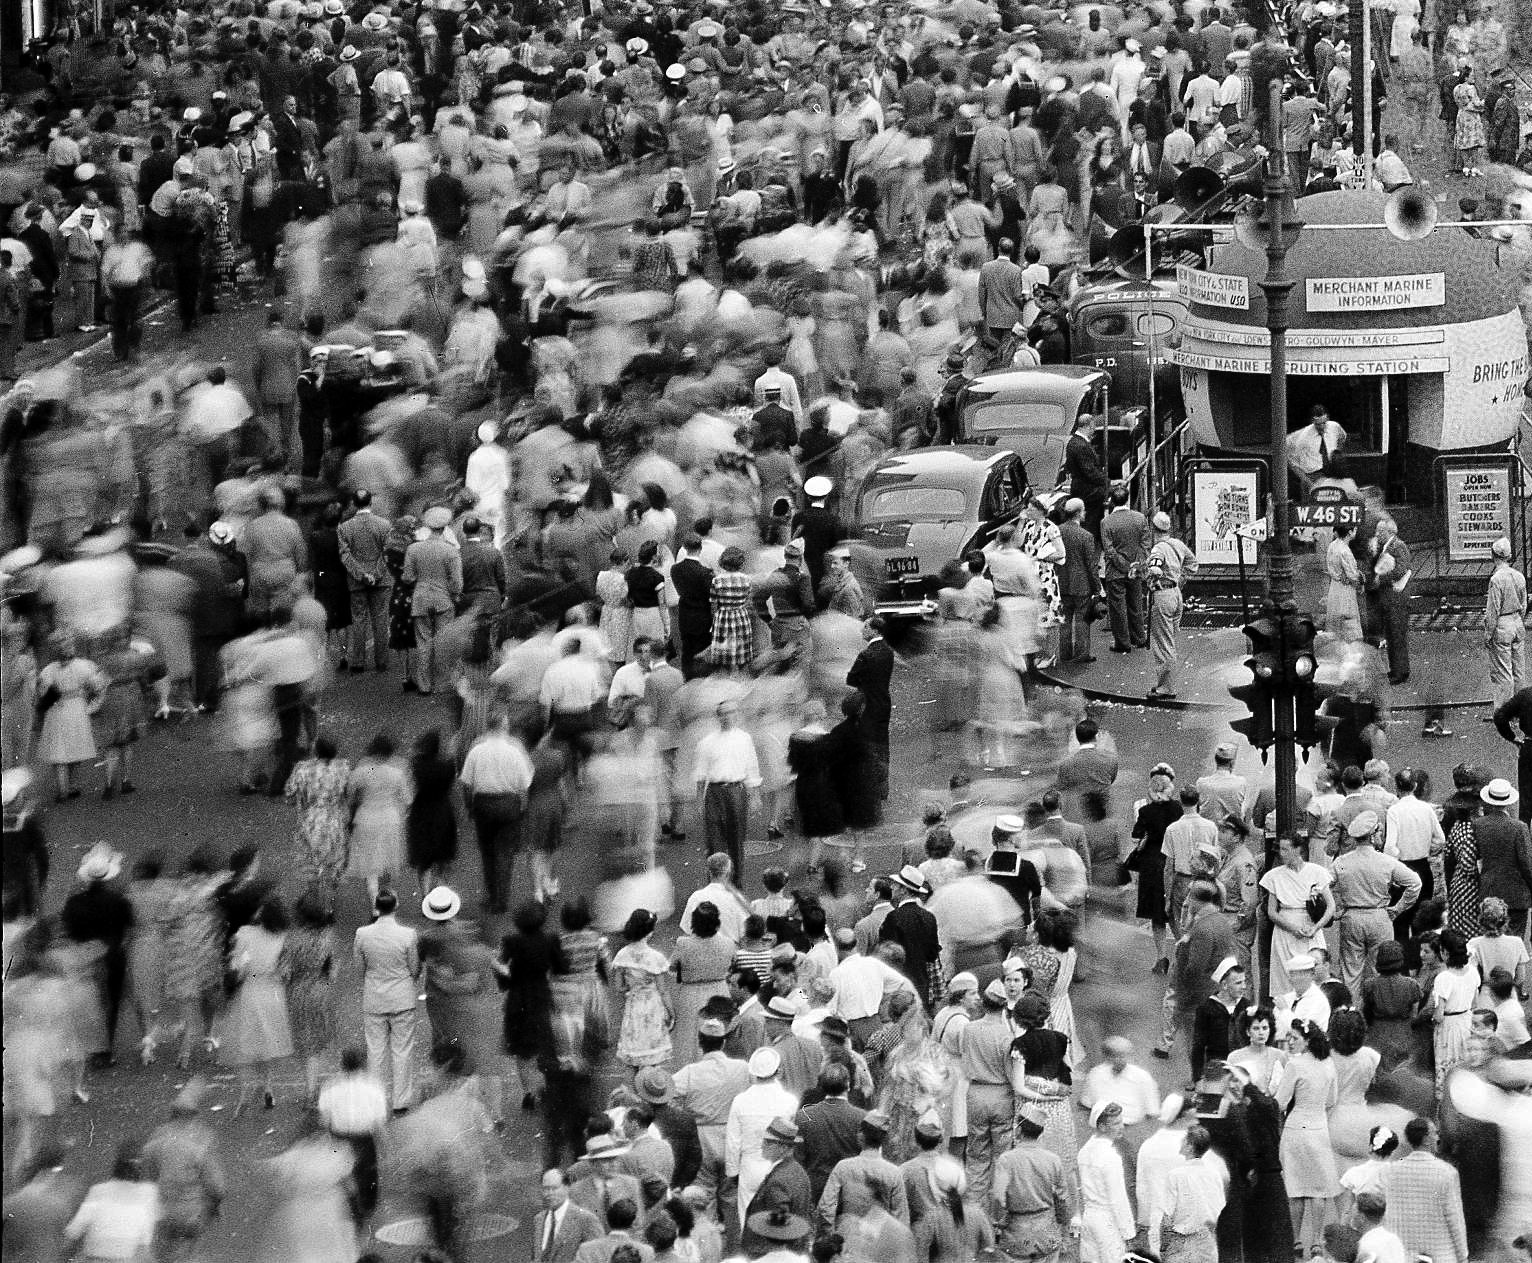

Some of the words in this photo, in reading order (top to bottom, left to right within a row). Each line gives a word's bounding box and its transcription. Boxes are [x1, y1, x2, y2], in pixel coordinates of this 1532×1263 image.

[1218, 277, 1244, 292] STATE
[1312, 281, 1379, 295] MERCHANT
[1383, 278, 1433, 292] MARINE
[1093, 290, 1172, 302] POLICE
[1229, 294, 1246, 306] USO
[1338, 293, 1412, 307] INFORMATION
[1305, 336, 1356, 346] GOLDWYN
[1361, 335, 1400, 345] MAYER
[1214, 359, 1260, 373] MARINE
[1264, 362, 1350, 375] RCRUITING
[1356, 360, 1420, 374] STATION
[1472, 361, 1509, 384] BRING
[1464, 475, 1489, 485] JOBS
[1296, 506, 1311, 523] W.
[1313, 506, 1335, 523] 46
[1340, 506, 1361, 523] ST.
[1462, 512, 1494, 521] COOKS
[1458, 521, 1503, 532] STEWARDS
